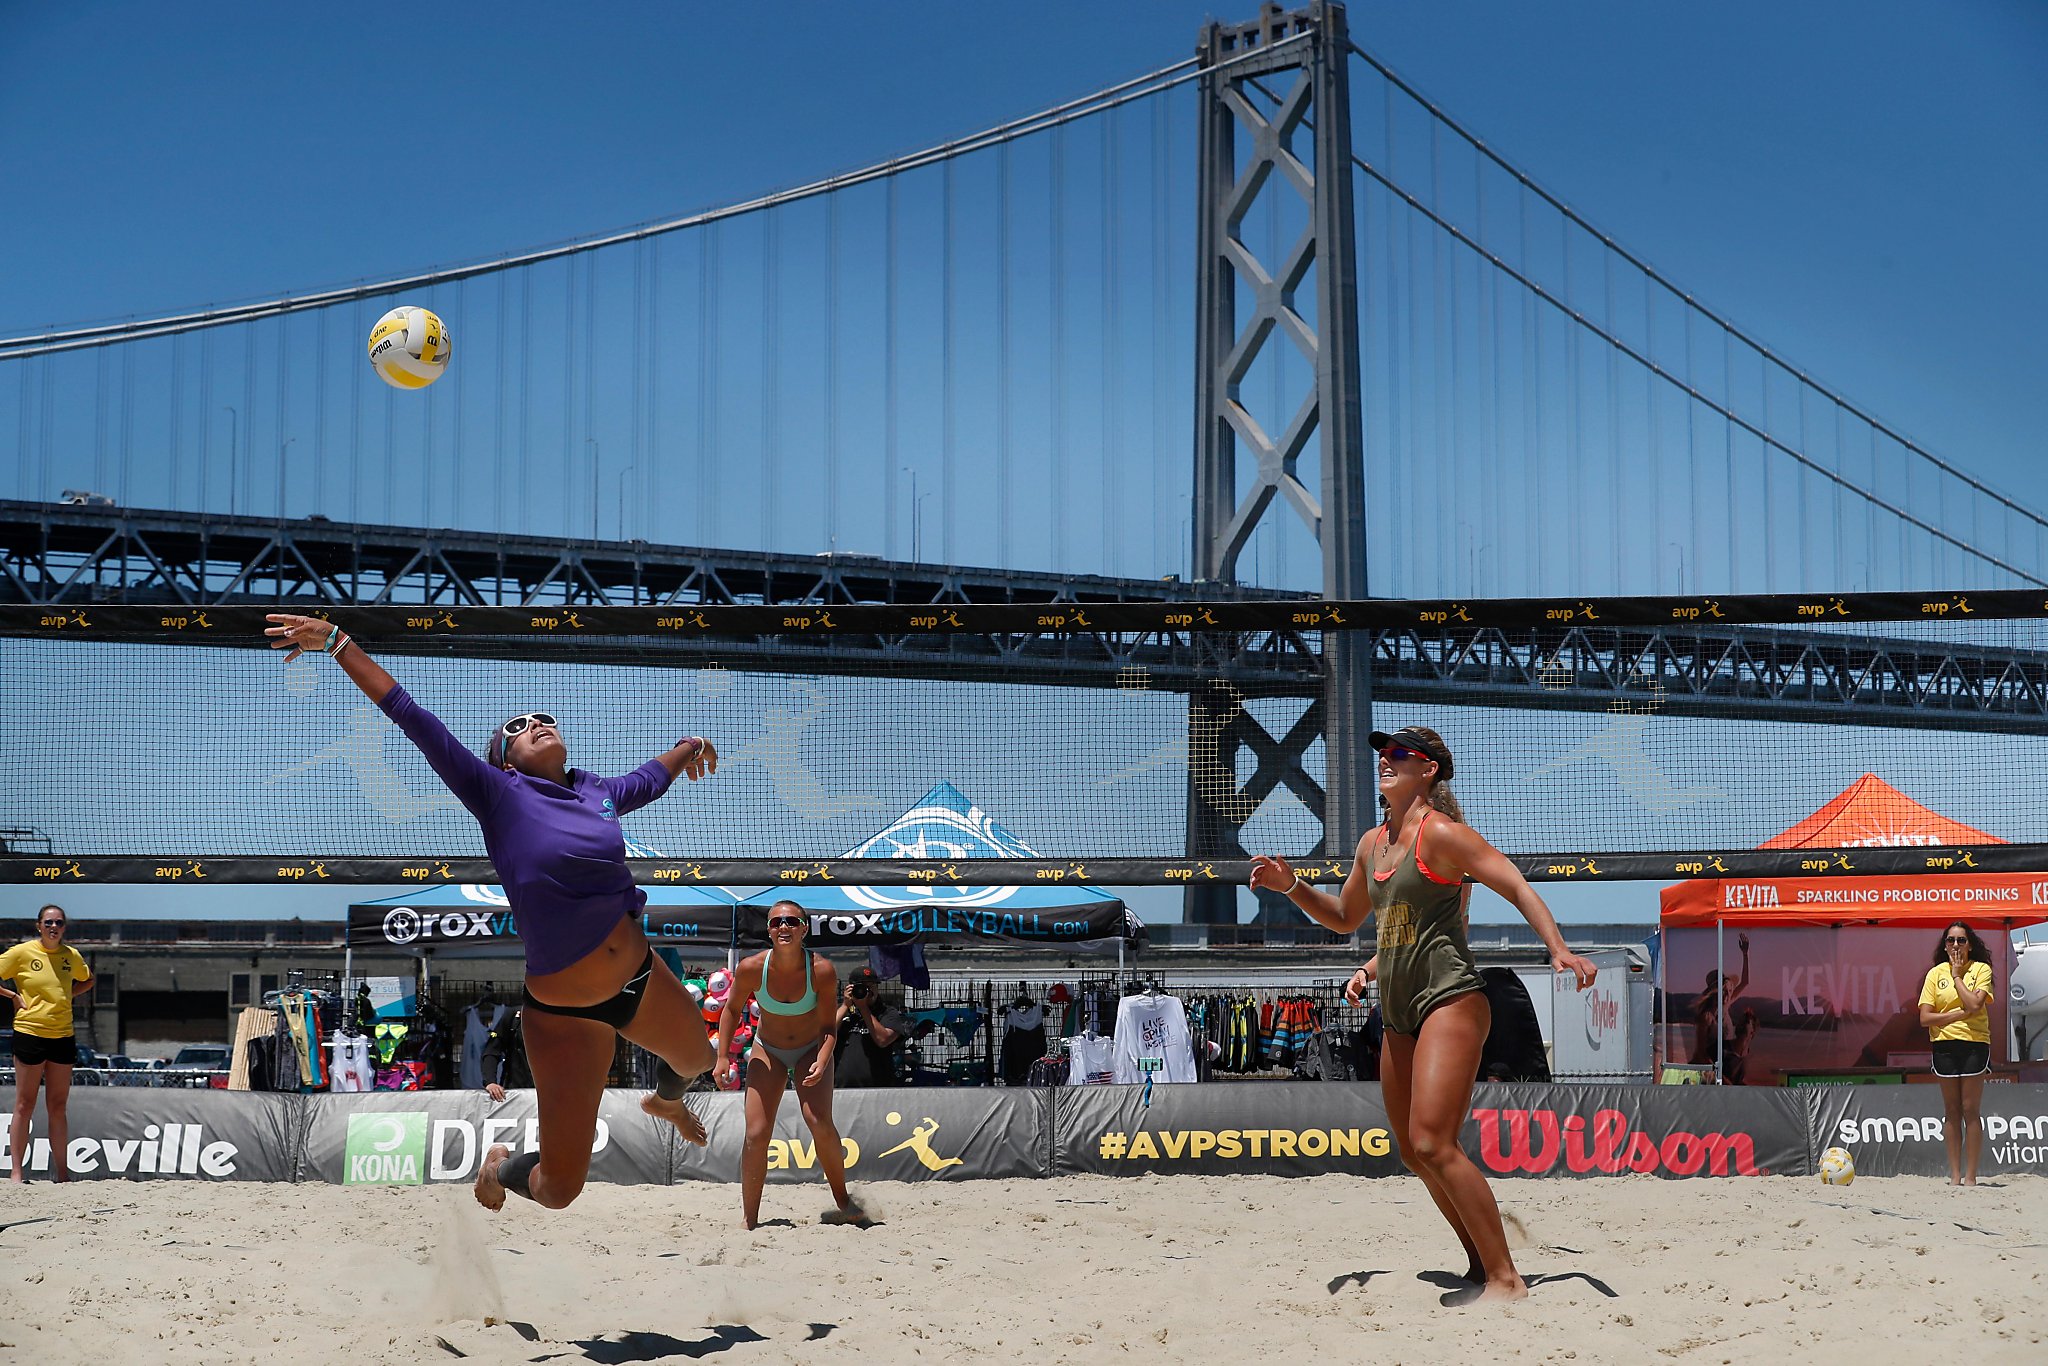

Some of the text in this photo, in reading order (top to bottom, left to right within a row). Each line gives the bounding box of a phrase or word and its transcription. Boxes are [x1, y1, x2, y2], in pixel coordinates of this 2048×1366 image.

[1546, 609, 1574, 622] avp
[1672, 607, 1700, 620] avp
[1797, 605, 1825, 618] avp
[1921, 602, 1949, 616] avp
[40, 616, 67, 628] avp
[161, 617, 188, 629] avp
[407, 617, 434, 629] avp
[531, 617, 559, 630] avp
[656, 617, 684, 629] avp
[783, 617, 811, 629] avp
[911, 616, 938, 629] avp
[1037, 616, 1065, 628] avp
[1165, 614, 1193, 626] avp
[1292, 613, 1320, 625] avp
[1419, 611, 1447, 624] avp
[1676, 862, 1703, 874] avp
[1801, 859, 1829, 873] avp
[1925, 857, 1954, 870] avp
[33, 867, 61, 880] avp
[155, 867, 183, 879] avp
[278, 867, 305, 879] avp
[401, 867, 430, 881] avp
[654, 869, 682, 881] avp
[781, 869, 809, 881] avp
[907, 870, 937, 881] avp
[1035, 869, 1065, 881] avp
[1164, 868, 1193, 881] avp
[1293, 867, 1321, 880] avp
[1548, 864, 1577, 877] avp
[1725, 884, 1781, 909] KEVITA
[1796, 889, 1879, 904] SPARKLING
[1883, 889, 1961, 903] PROBIOTIC
[1964, 887, 2019, 901] DRINKS
[1782, 962, 1902, 1018] KEVITA
[1592, 989, 1619, 1037] Ryder
[1142, 1016, 1165, 1031] LIVE
[1099, 1127, 1391, 1160] #AVPSTRONG
[1472, 1108, 1760, 1177] Wilson
[350, 1154, 418, 1182] KONA
